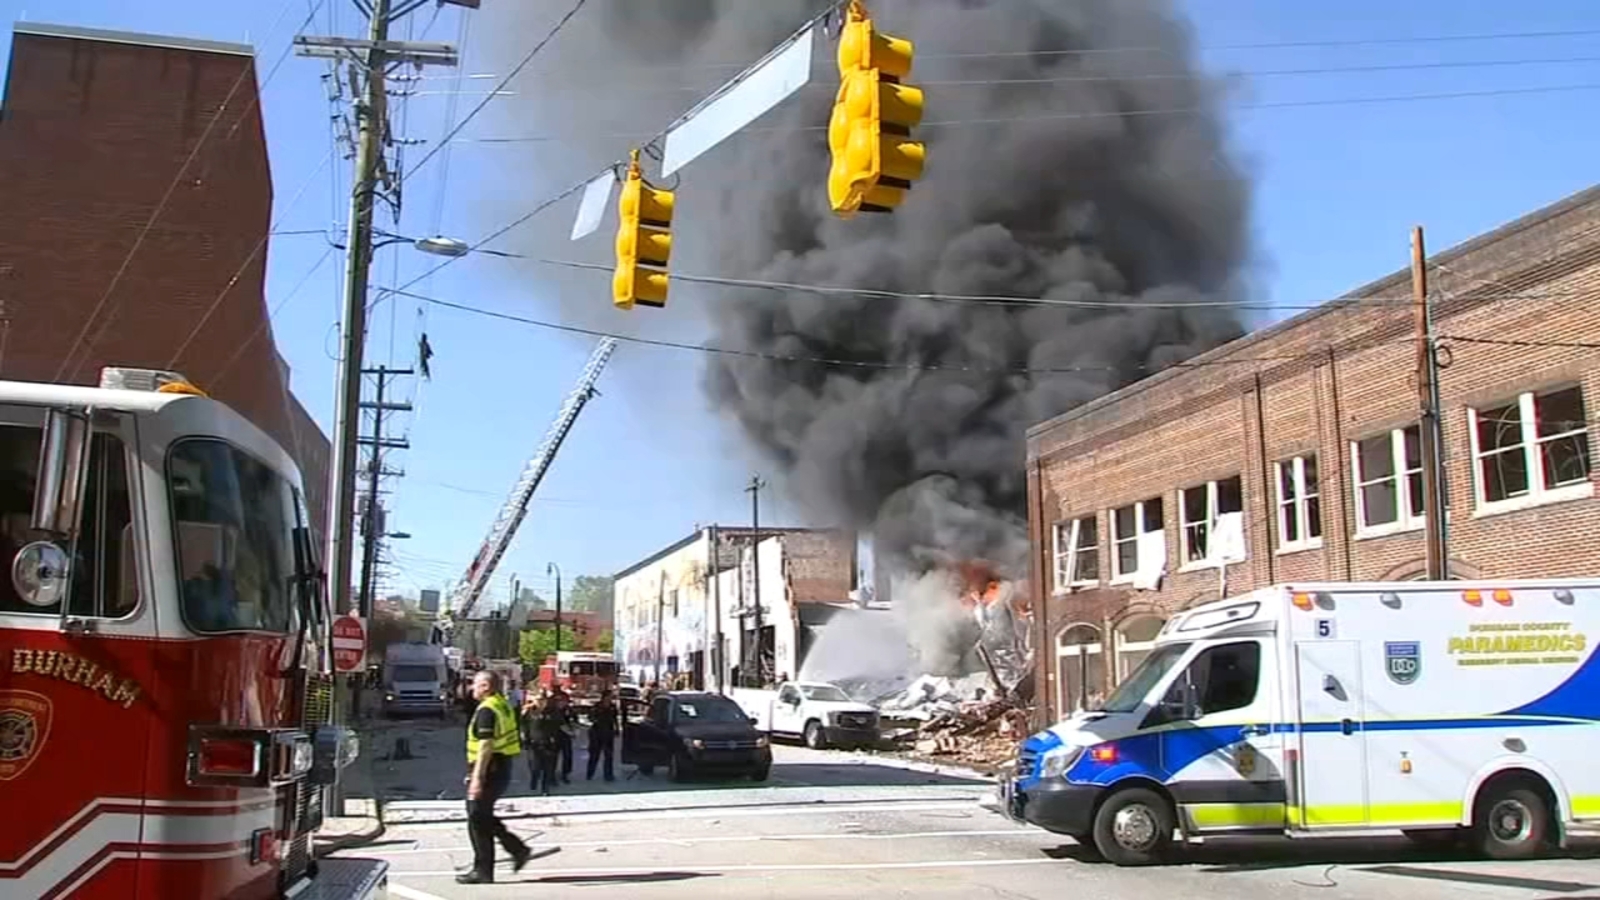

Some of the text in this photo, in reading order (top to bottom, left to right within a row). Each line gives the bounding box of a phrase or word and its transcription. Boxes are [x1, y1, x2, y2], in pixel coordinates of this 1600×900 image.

[1319, 619, 1330, 637] 5
[1448, 634, 1586, 653] PARAMEDICS
[12, 648, 140, 709] DURHAM
